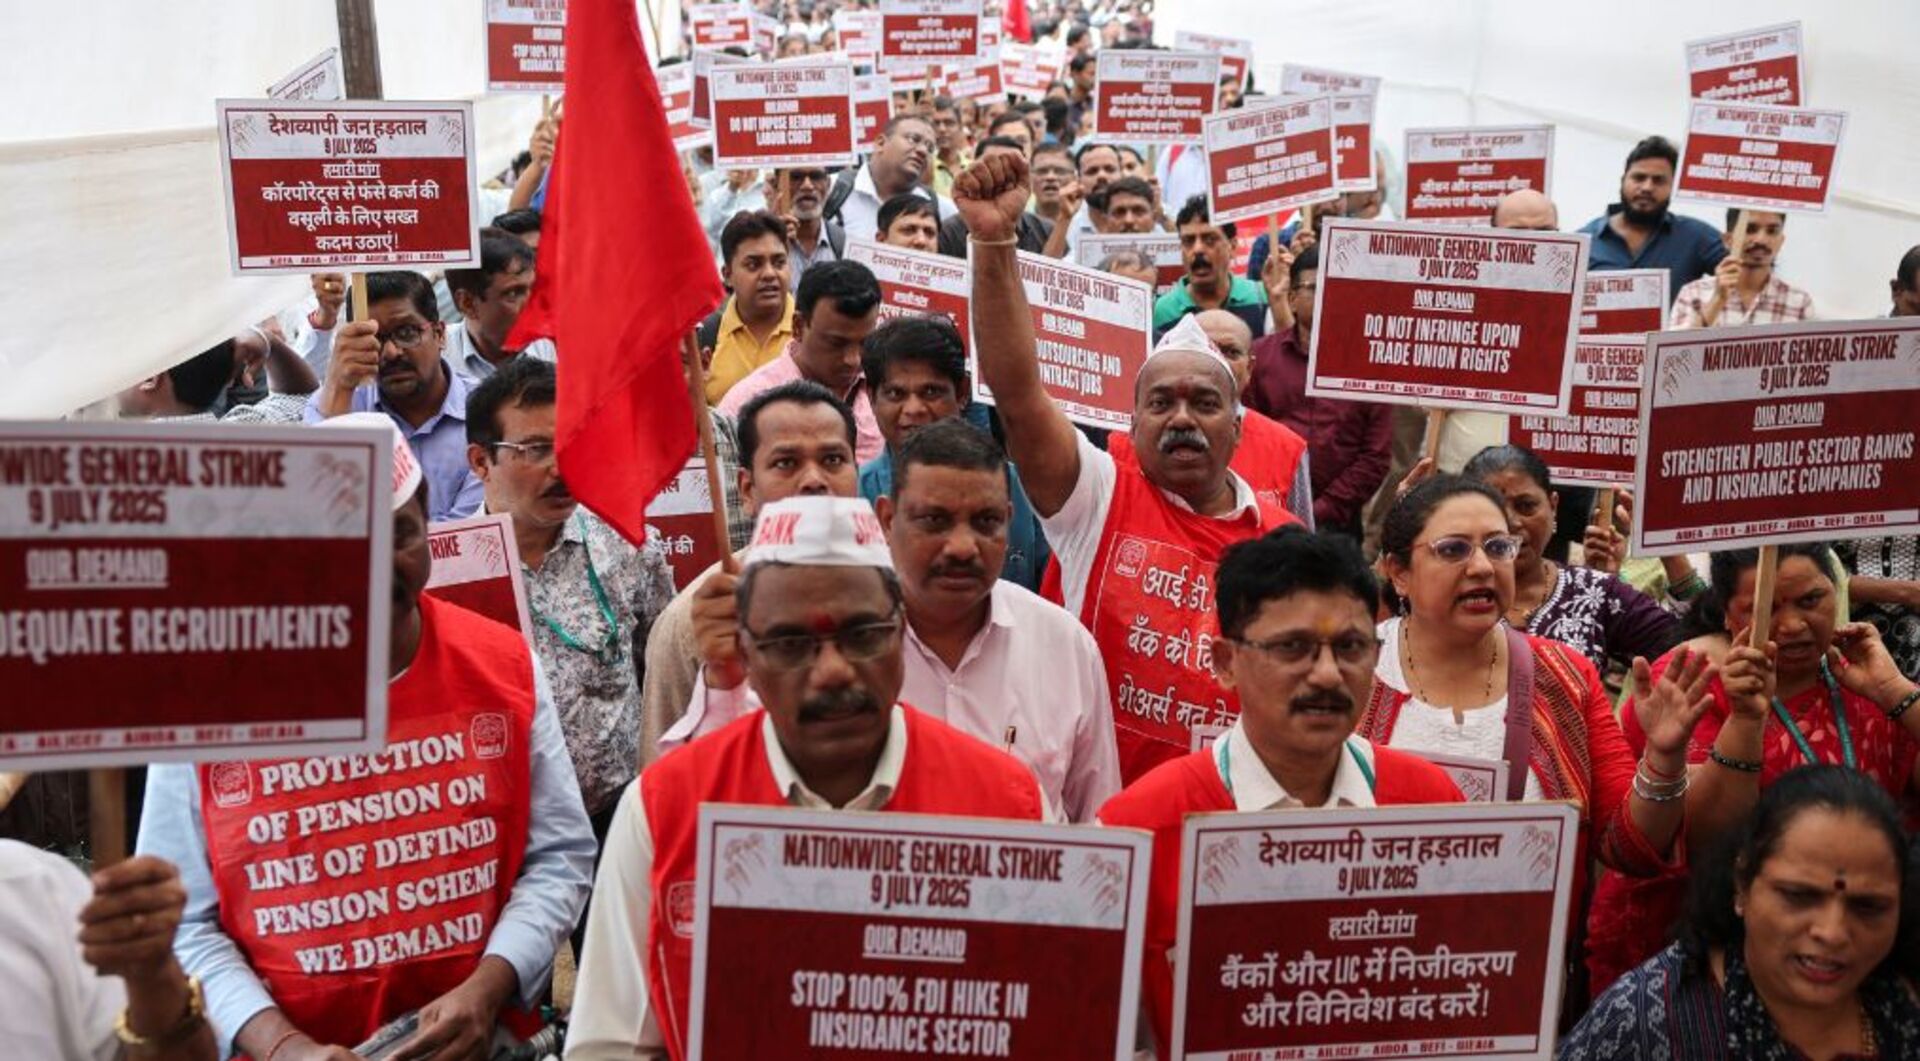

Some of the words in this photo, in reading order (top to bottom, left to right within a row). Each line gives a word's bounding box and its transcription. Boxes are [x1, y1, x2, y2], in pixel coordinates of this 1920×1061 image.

[343, 119, 370, 136] जन
[332, 137, 351, 157] JULY
[354, 138, 377, 154] 2025
[342, 182, 356, 199] से
[419, 180, 440, 200] की
[288, 206, 332, 231] वसूली
[334, 207, 351, 225] के
[351, 206, 383, 228] लिए
[316, 235, 353, 251] कदम
[1369, 234, 1441, 259] NATIONWIDE
[1443, 239, 1493, 263] GENERAL
[1495, 243, 1537, 265] STRIKE
[1418, 258, 1425, 276] 9
[1426, 260, 1450, 280] JULY
[1452, 261, 1479, 280] 2025
[1412, 289, 1433, 309] OUR
[1434, 291, 1475, 313] DEMAND
[1364, 314, 1383, 337] DO
[1386, 316, 1412, 339] NOT
[1415, 318, 1478, 345] INFRINGE
[1481, 321, 1520, 348] UPON
[1101, 353, 1122, 377] AND
[1368, 340, 1410, 365] TRADE
[1413, 344, 1457, 370] UNION
[1460, 346, 1510, 373] RIGHTS
[1606, 347, 1644, 366] GENERA
[1703, 340, 1785, 371] NATIONWIDE
[1788, 337, 1847, 364] GENERAL
[1849, 334, 1900, 361] STRIKE
[1080, 372, 1103, 396] JOBS
[1760, 369, 1768, 390] 9
[1769, 366, 1798, 393] JULY
[1800, 364, 1831, 387] 2025
[1583, 416, 1639, 436] MEASURES
[1753, 405, 1777, 431] OUR
[1779, 401, 1825, 429] DEMAND
[1555, 434, 1587, 452] LOANS
[1590, 436, 1620, 455] FROM
[1661, 446, 1751, 478] STRENGTHEN
[1754, 442, 1804, 469] PUBLIC
[1808, 438, 1860, 466] SECTOR
[1864, 432, 1914, 461] BANKS
[79, 447, 192, 487] GENERAL
[200, 448, 287, 488] STRIKE
[1683, 476, 1712, 504] AND
[1716, 470, 1796, 501] INSURANCE
[1799, 464, 1883, 493] COMPANIES
[29, 490, 44, 524] 9
[50, 489, 100, 530] JULY
[108, 489, 167, 525] 2025
[26, 549, 73, 589] OUR
[77, 549, 168, 588] DEMAND
[131, 605, 351, 654] RECRUITMENTS
[260, 732, 465, 797] PROTECTION
[247, 810, 290, 844] OF
[294, 782, 443, 838] PENSION
[447, 773, 486, 805] ON
[244, 852, 319, 891] LINE
[323, 843, 368, 878] OF
[375, 815, 498, 869] DEFINED
[783, 833, 907, 874] NATIONWIDE
[910, 842, 992, 878] GENERAL
[997, 849, 1064, 882] STRIKE
[1259, 829, 1366, 867] देशव्यापी
[1372, 834, 1413, 861] जन
[1417, 831, 1503, 867] हड़ताल
[870, 875, 882, 902] 9
[885, 875, 924, 909] JULY
[927, 878, 970, 908] 2025
[1338, 867, 1347, 890] 9
[1349, 866, 1381, 895] JULY
[1383, 866, 1418, 890] 2025
[254, 886, 390, 936] PENSION
[1329, 909, 1379, 939] हमारी
[295, 944, 348, 975] WE
[352, 911, 485, 971] DEMAND
[862, 924, 898, 960] OUR
[900, 926, 967, 963] DEMAND
[1220, 950, 1279, 989] बैंकों
[1280, 948, 1330, 985] और
[1334, 954, 1362, 985] LIC
[1363, 948, 1389, 983] में
[1389, 945, 1517, 982] निजीकरण
[791, 970, 846, 1009] STOP
[847, 972, 909, 1012] 100%
[912, 976, 948, 1015] FDI
[952, 980, 1002, 1018] HIKE
[1004, 983, 1029, 1018] IN
[1242, 994, 1298, 1028] और
[1297, 988, 1395, 1027] विनिवेश
[1398, 986, 1435, 1022] बंद
[809, 1011, 930, 1054] INSURANCE
[933, 1017, 1012, 1058] SECTOR
